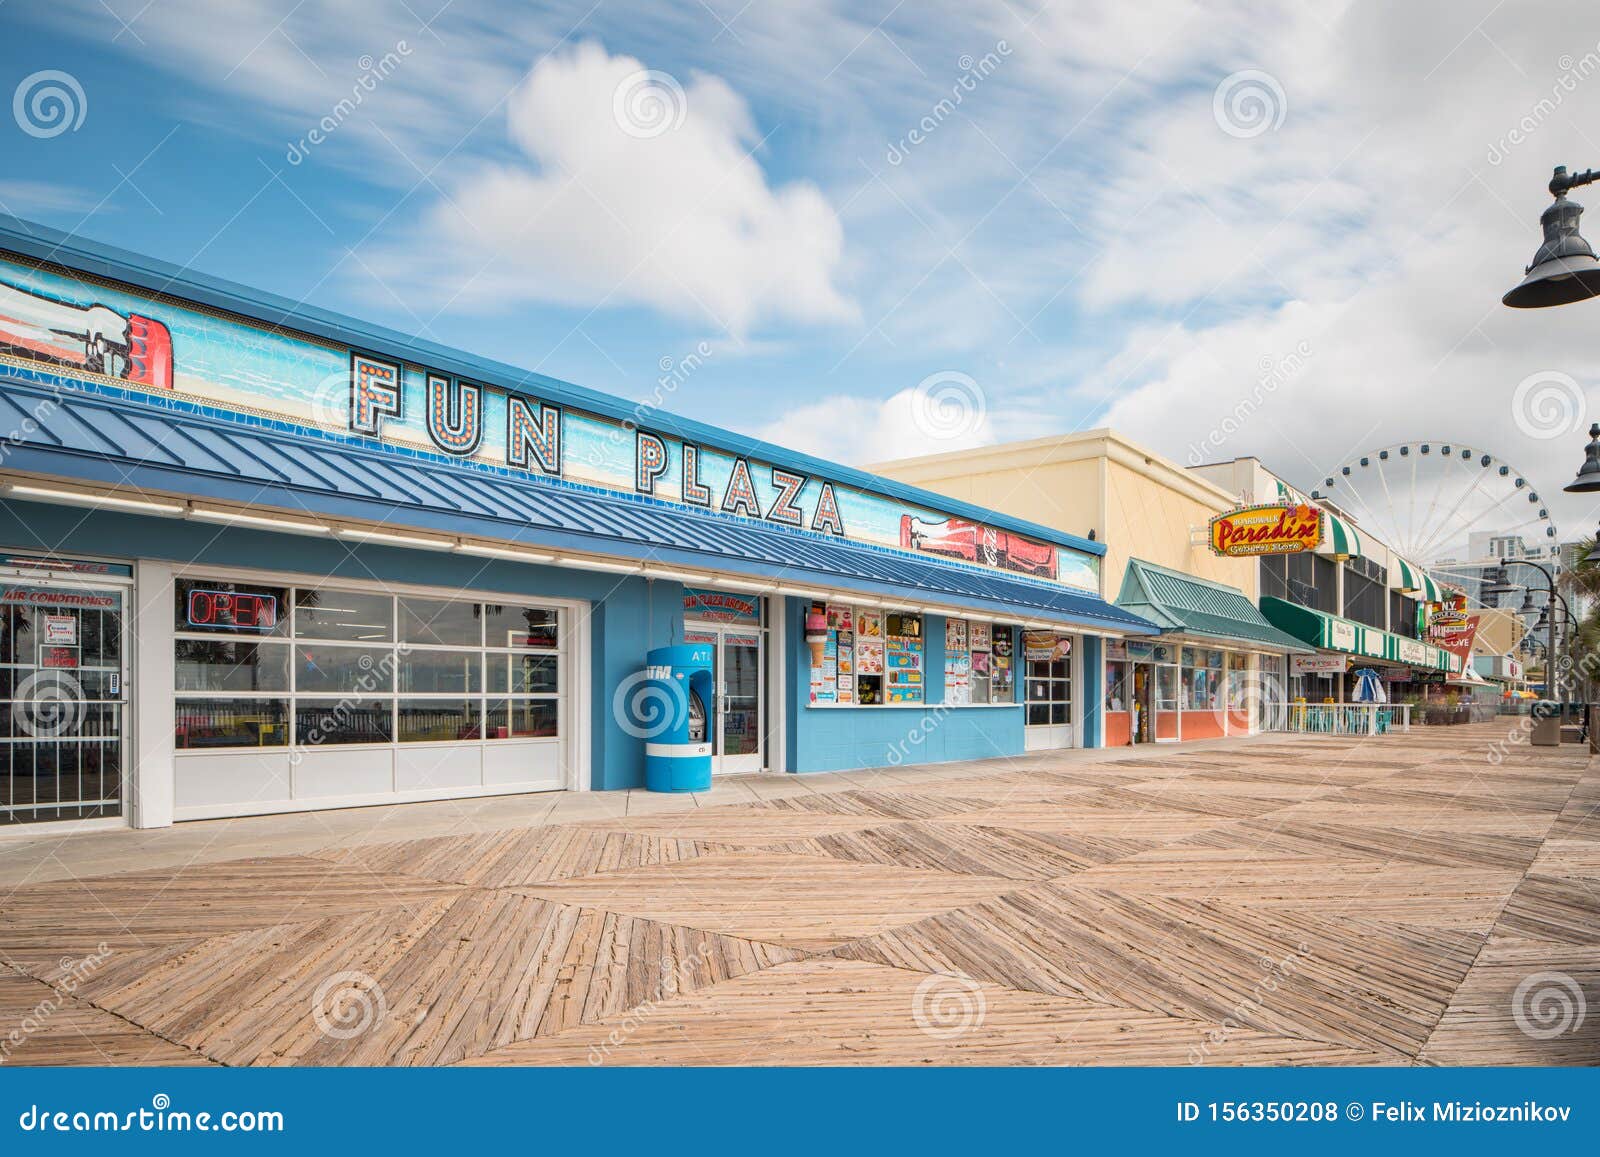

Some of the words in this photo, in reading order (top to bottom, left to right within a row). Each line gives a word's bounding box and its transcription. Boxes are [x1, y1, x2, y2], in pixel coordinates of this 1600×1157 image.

[350, 351, 563, 477] FUN
[635, 429, 844, 537] PLAZA
[1218, 511, 1317, 551] Paradise
[1234, 515, 1279, 526] BOARDWALK
[1272, 543, 1300, 551] Store
[3, 591, 28, 601] AIR
[29, 591, 113, 607] CONDITIONED
[190, 591, 275, 627] OPEN
[683, 595, 697, 608] UN
[698, 594, 724, 606] PLAZA
[724, 596, 755, 616] ARCADE
